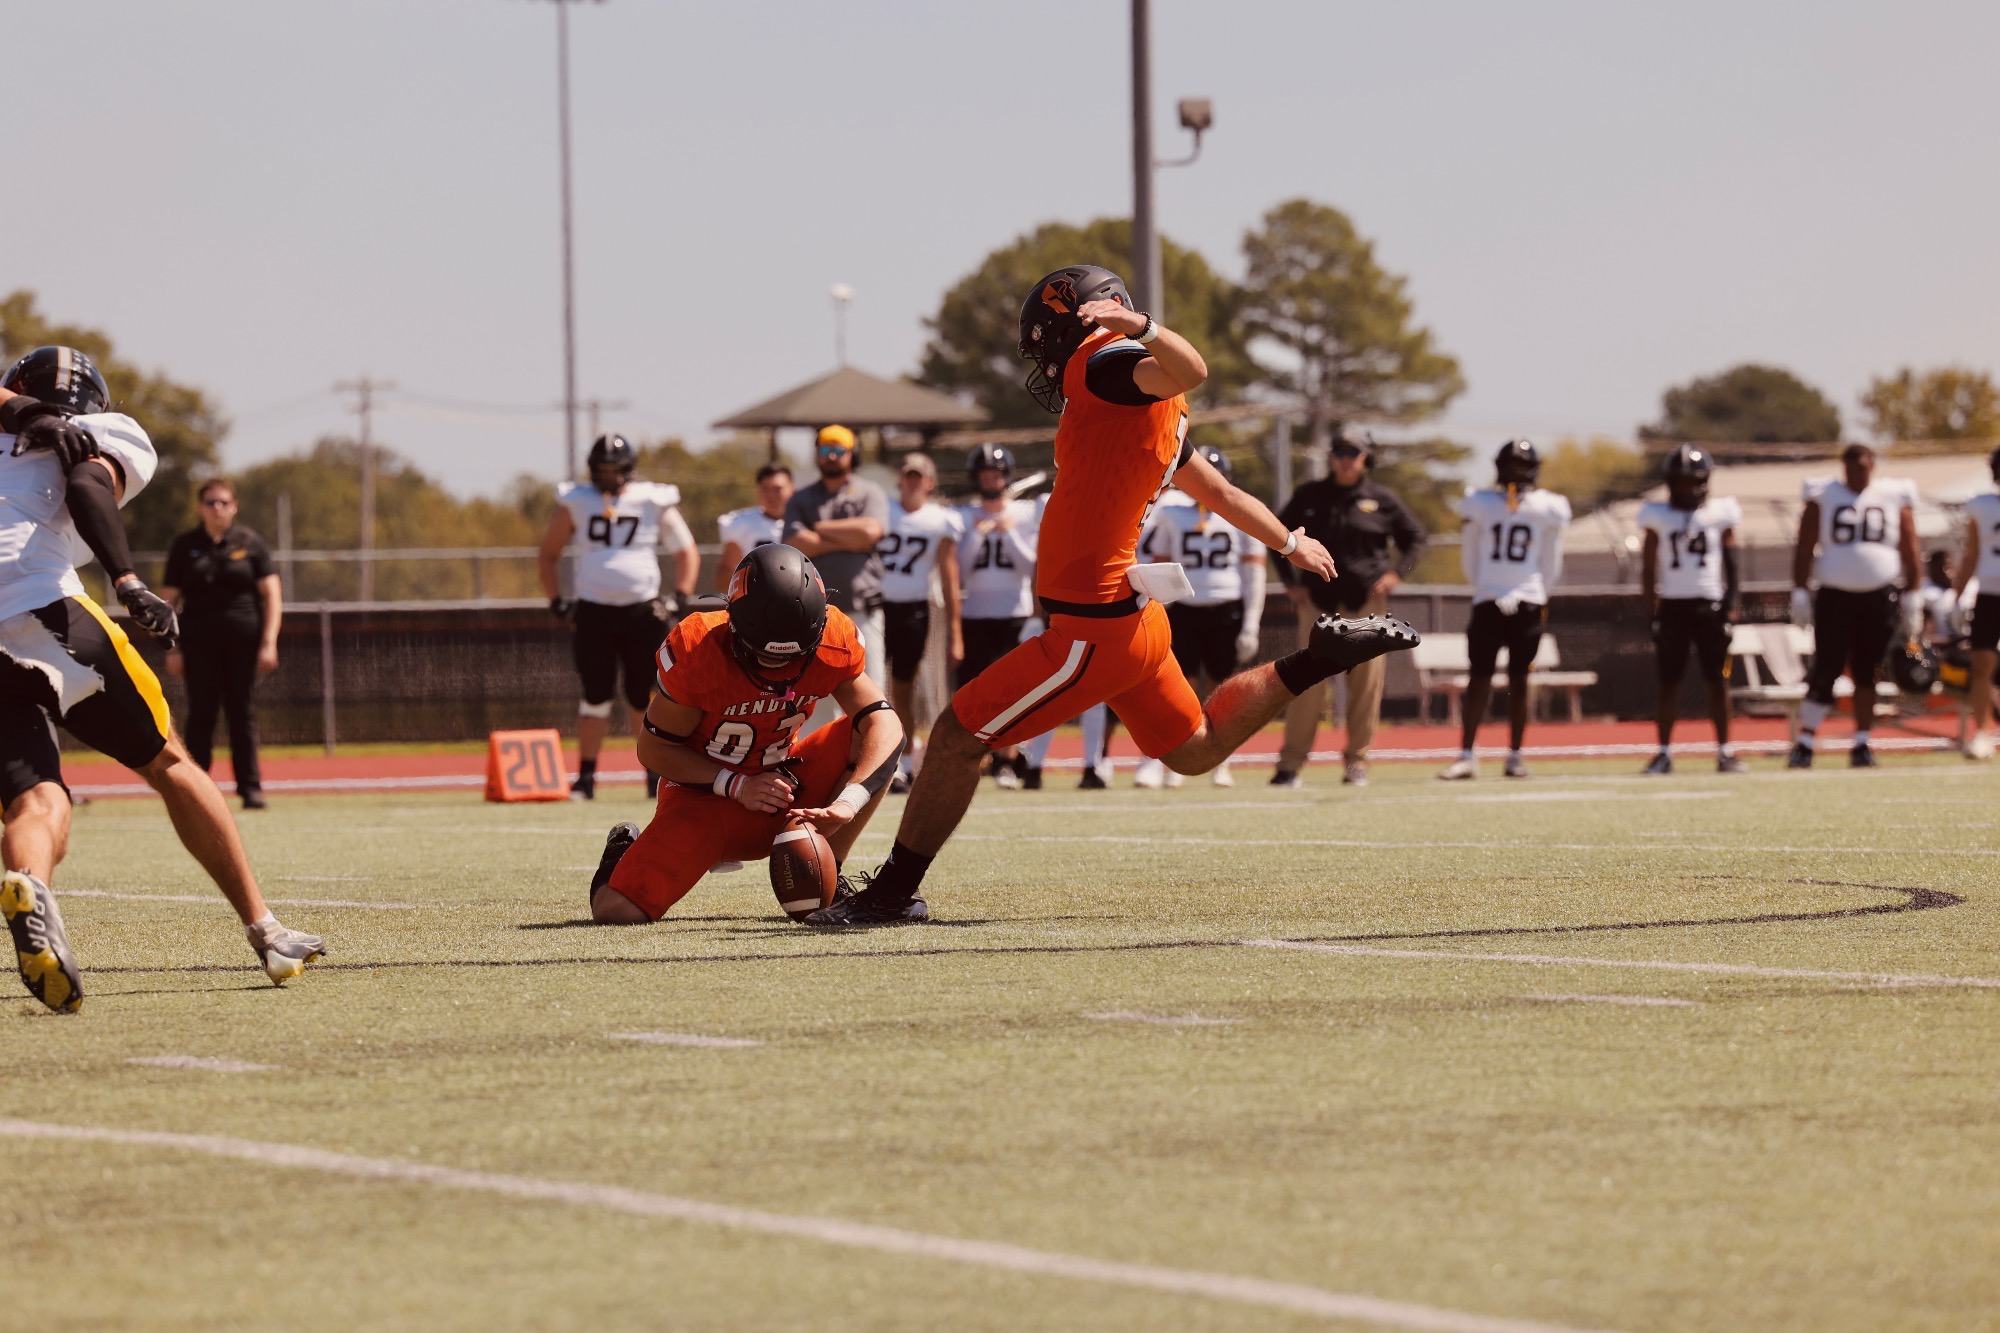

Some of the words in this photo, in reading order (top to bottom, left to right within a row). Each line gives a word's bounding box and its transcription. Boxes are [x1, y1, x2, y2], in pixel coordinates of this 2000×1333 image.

[588, 515, 639, 547] 97
[1491, 523, 1532, 562] 18
[1833, 506, 1886, 543] 60
[876, 532, 928, 574] 27
[1182, 531, 1232, 568] 52
[1669, 530, 1707, 569] 14
[501, 741, 560, 791] 20
[783, 853, 795, 890] Wilson
